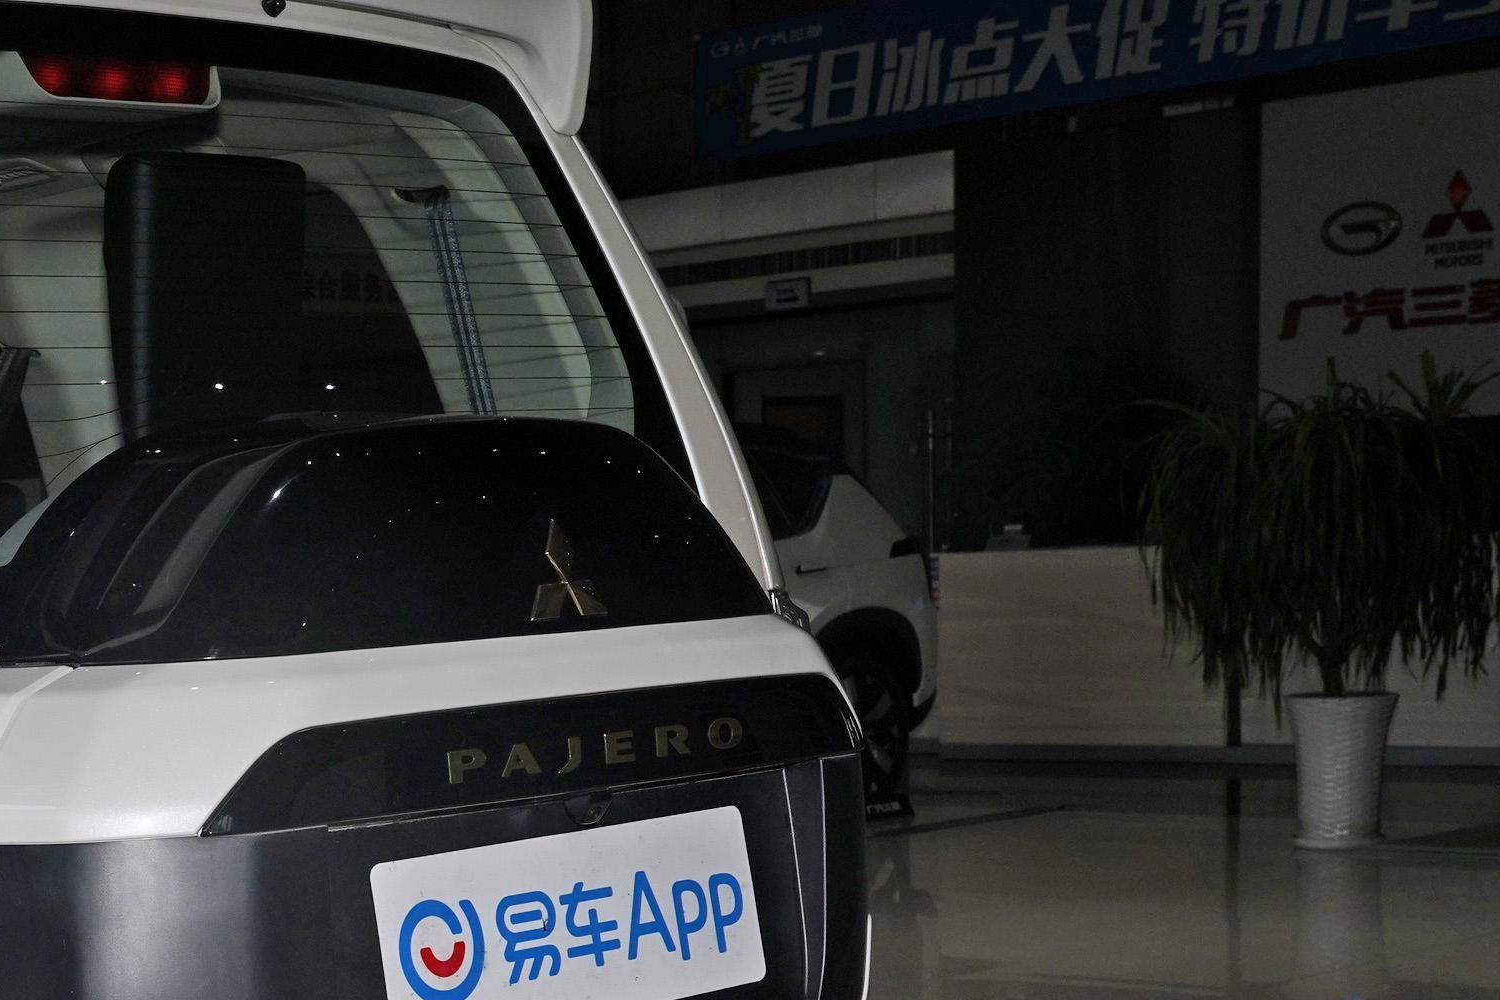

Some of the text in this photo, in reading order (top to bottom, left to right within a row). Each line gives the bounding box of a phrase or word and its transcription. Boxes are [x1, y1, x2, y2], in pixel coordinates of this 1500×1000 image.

[750, 0, 1169, 138] 夏日冰点大促
[1425, 238, 1493, 255] MITSUBISHI
[1434, 254, 1483, 269] MOTORS
[446, 717, 744, 784] PAJERO
[496, 869, 744, 985] 易车App
